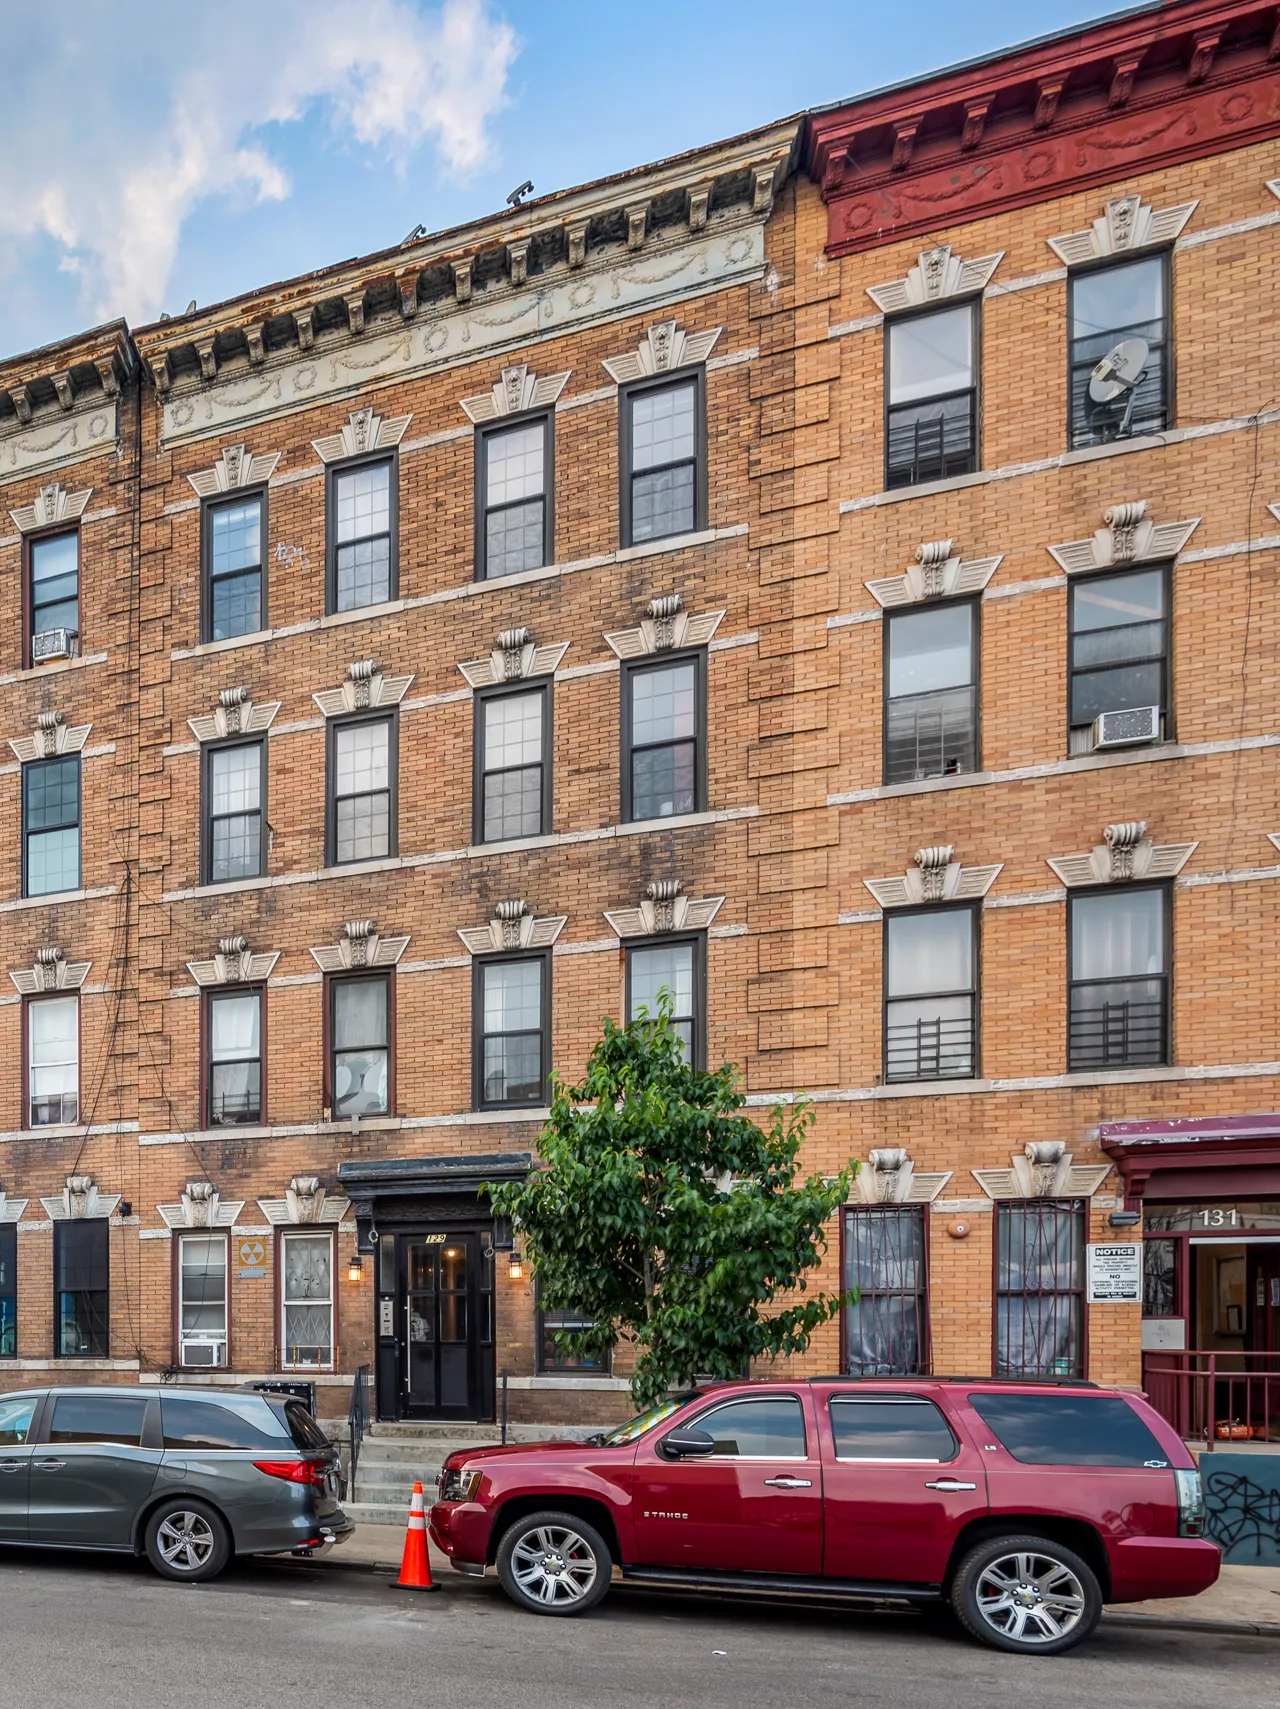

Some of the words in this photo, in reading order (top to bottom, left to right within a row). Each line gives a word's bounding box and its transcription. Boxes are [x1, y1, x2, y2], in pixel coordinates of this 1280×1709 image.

[1198, 1208, 1237, 1226] 131
[428, 1234, 445, 1242] 129
[1096, 1248, 1134, 1256] NOTICE
